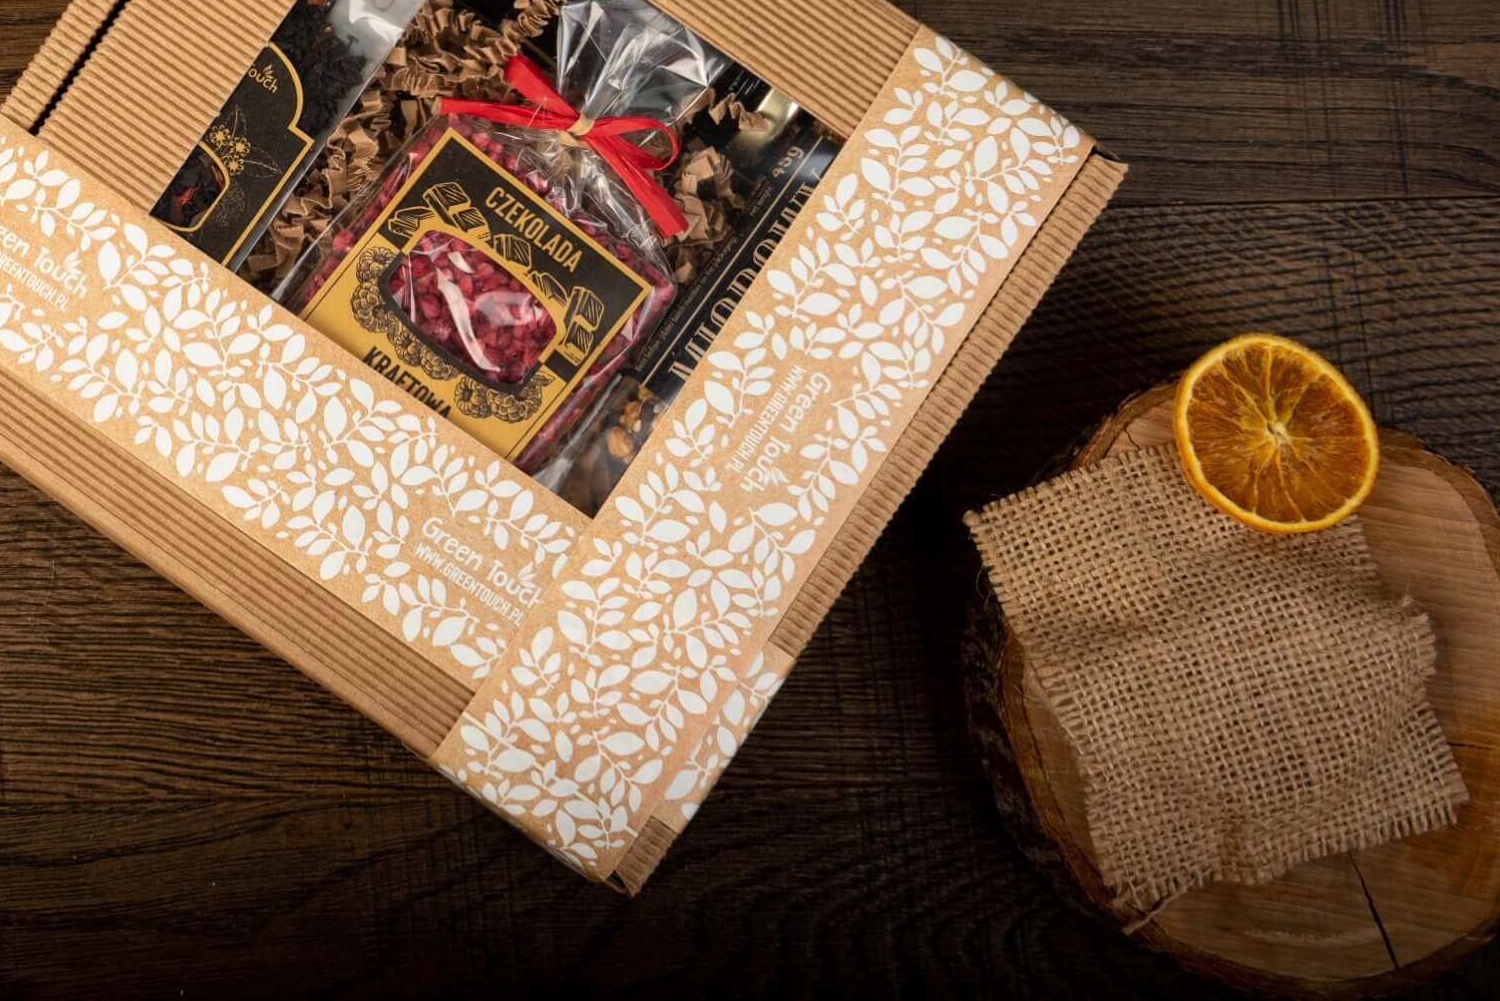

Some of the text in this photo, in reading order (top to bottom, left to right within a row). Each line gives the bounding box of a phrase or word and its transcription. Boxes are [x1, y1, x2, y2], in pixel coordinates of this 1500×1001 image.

[245, 62, 282, 94] ouch
[769, 142, 806, 181] 45g
[483, 184, 585, 273] CZEKOLADA
[30, 244, 94, 300] Touch
[361, 344, 453, 419] KRAFTOWA
[724, 363, 806, 475] WWW.GREENTOUCH.PL
[738, 369, 834, 498] Green Touch
[418, 513, 485, 572] Green
[413, 541, 526, 626] WWW.GREENTOUCH.PL
